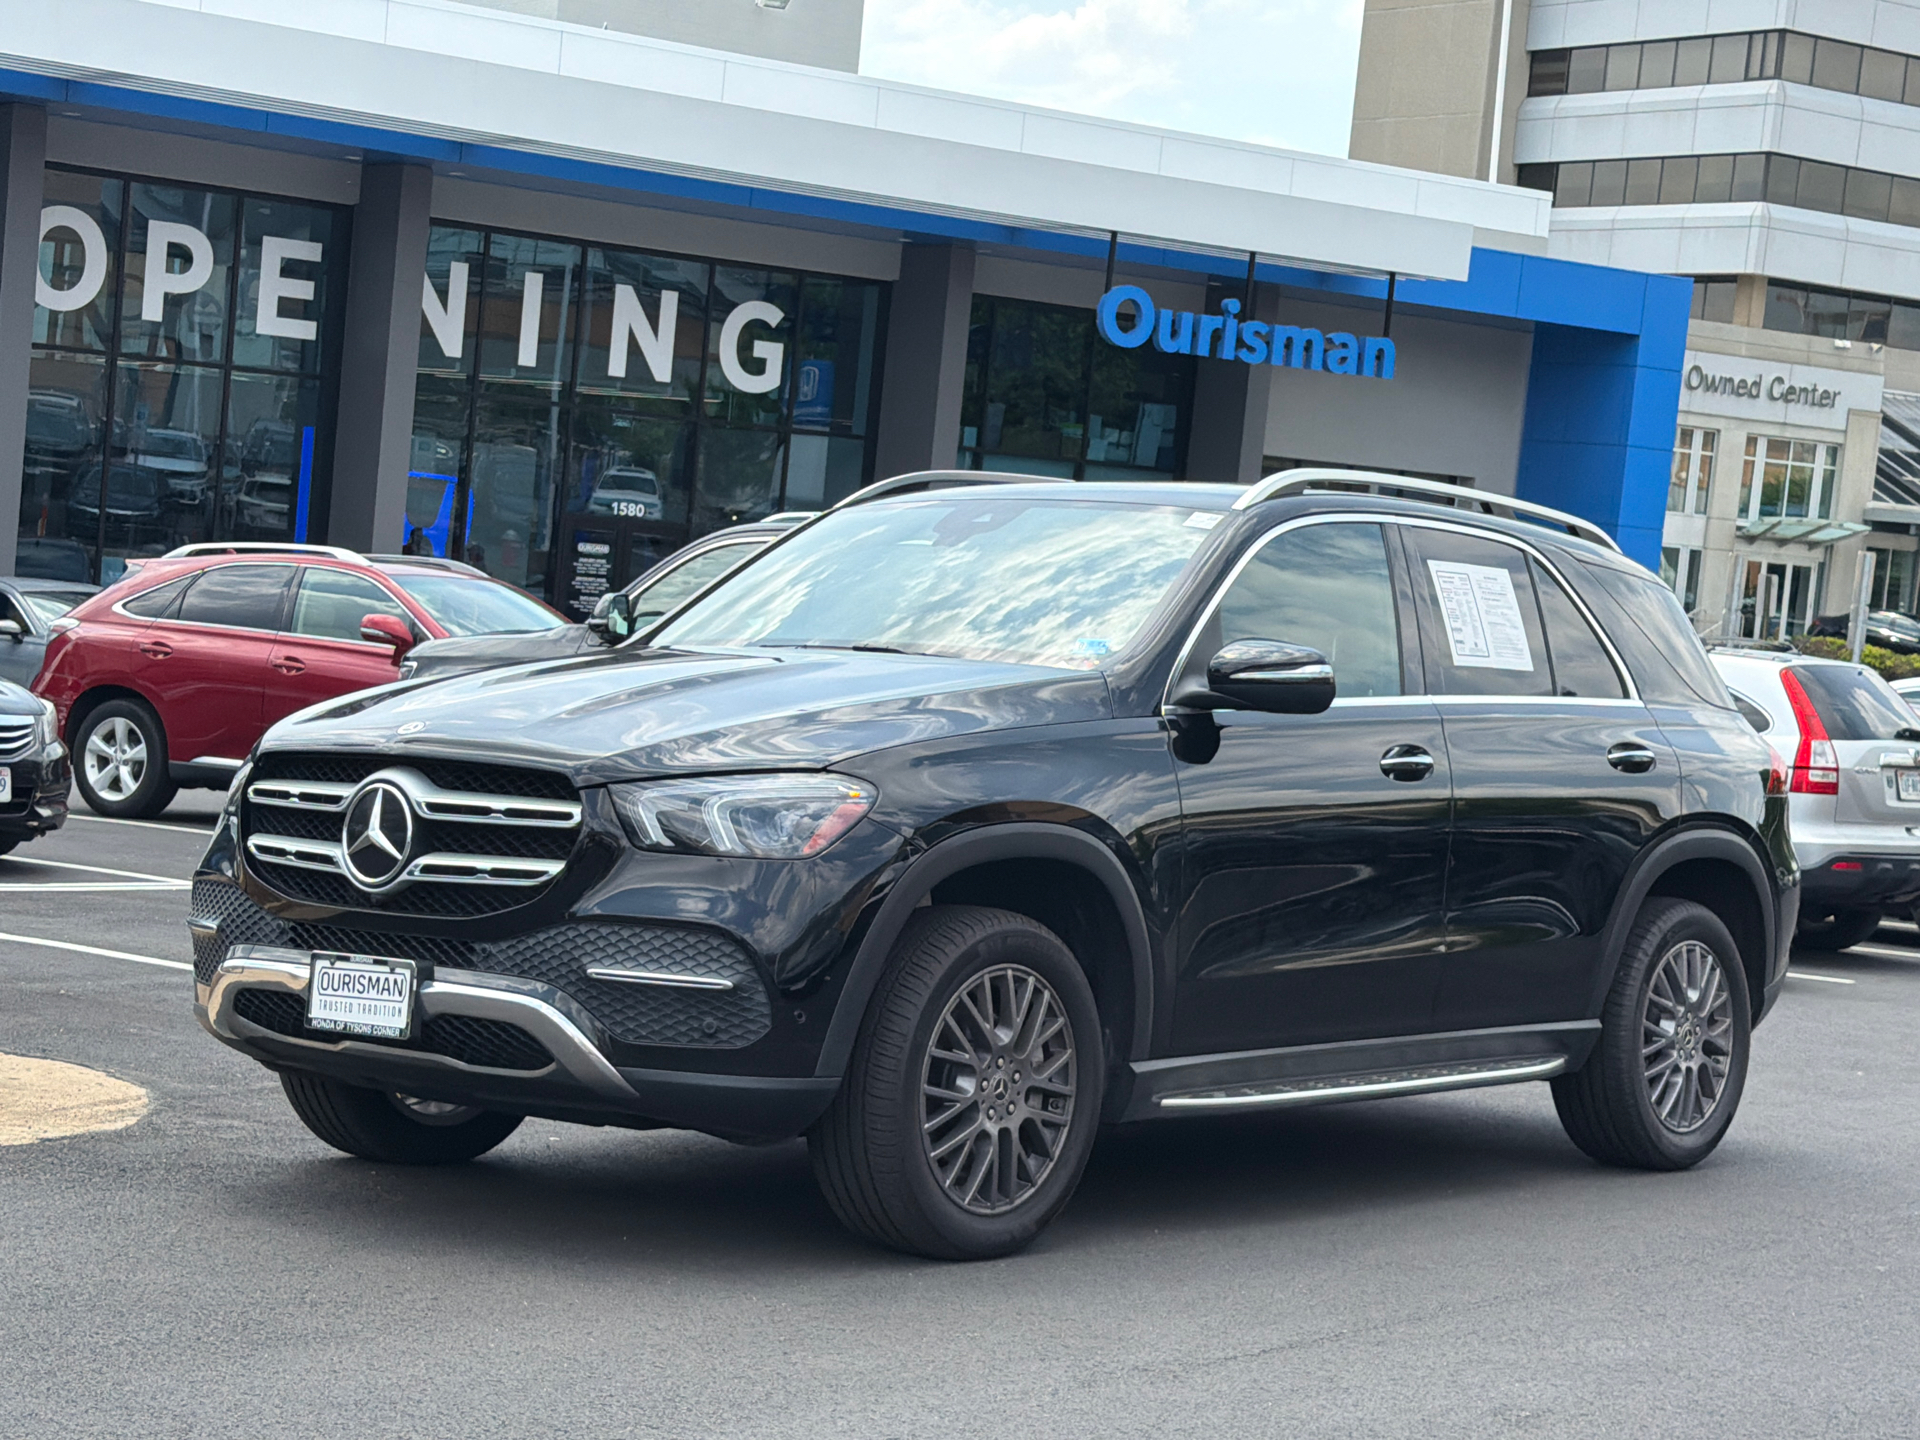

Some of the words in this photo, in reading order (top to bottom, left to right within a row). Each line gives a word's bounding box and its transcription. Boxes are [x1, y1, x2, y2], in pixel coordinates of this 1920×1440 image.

[1096, 284, 1396, 380] Ourisman
[1685, 364, 1762, 399] Owned
[1768, 375, 1841, 409] Center
[611, 502, 645, 517] 1580
[321, 972, 404, 997] OURISMAN
[319, 999, 354, 1014] TRUSTED
[357, 1003, 402, 1017] TRADITION
[312, 1019, 335, 1029] HONDA
[336, 1021, 345, 1030] OF
[346, 1023, 371, 1034] TYSONS
[373, 1026, 399, 1037] CORNER
